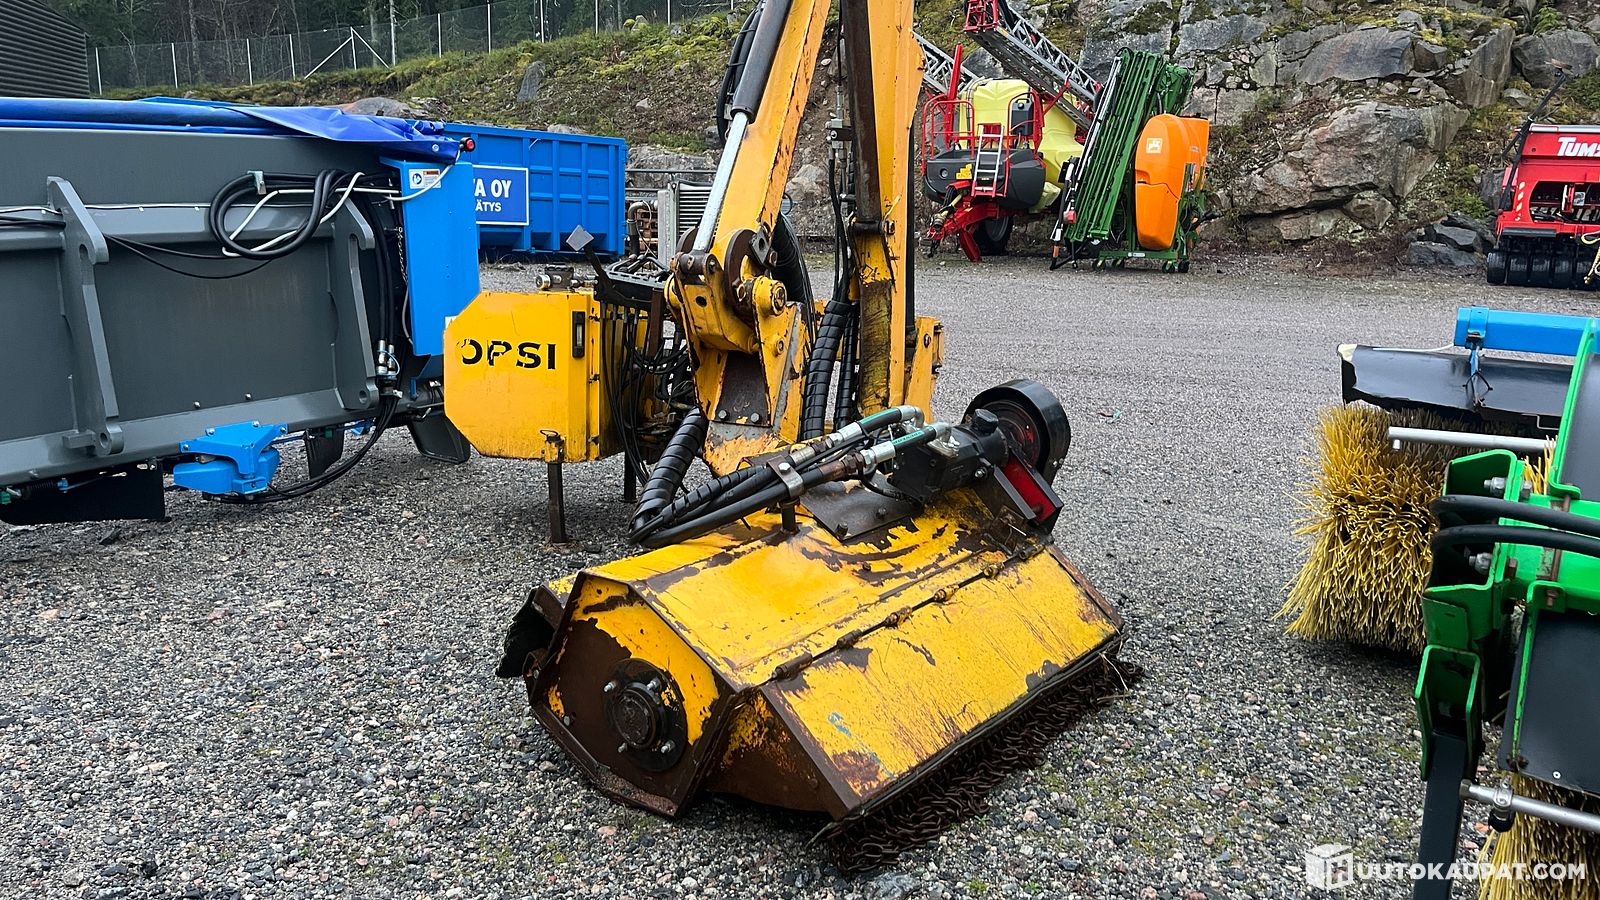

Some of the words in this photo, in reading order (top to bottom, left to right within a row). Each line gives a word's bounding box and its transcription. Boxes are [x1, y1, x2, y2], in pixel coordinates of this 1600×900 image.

[473, 178, 486, 197] A
[491, 179, 511, 198] OY
[475, 199, 502, 212] ÄTYS
[457, 338, 556, 370] OPSI
